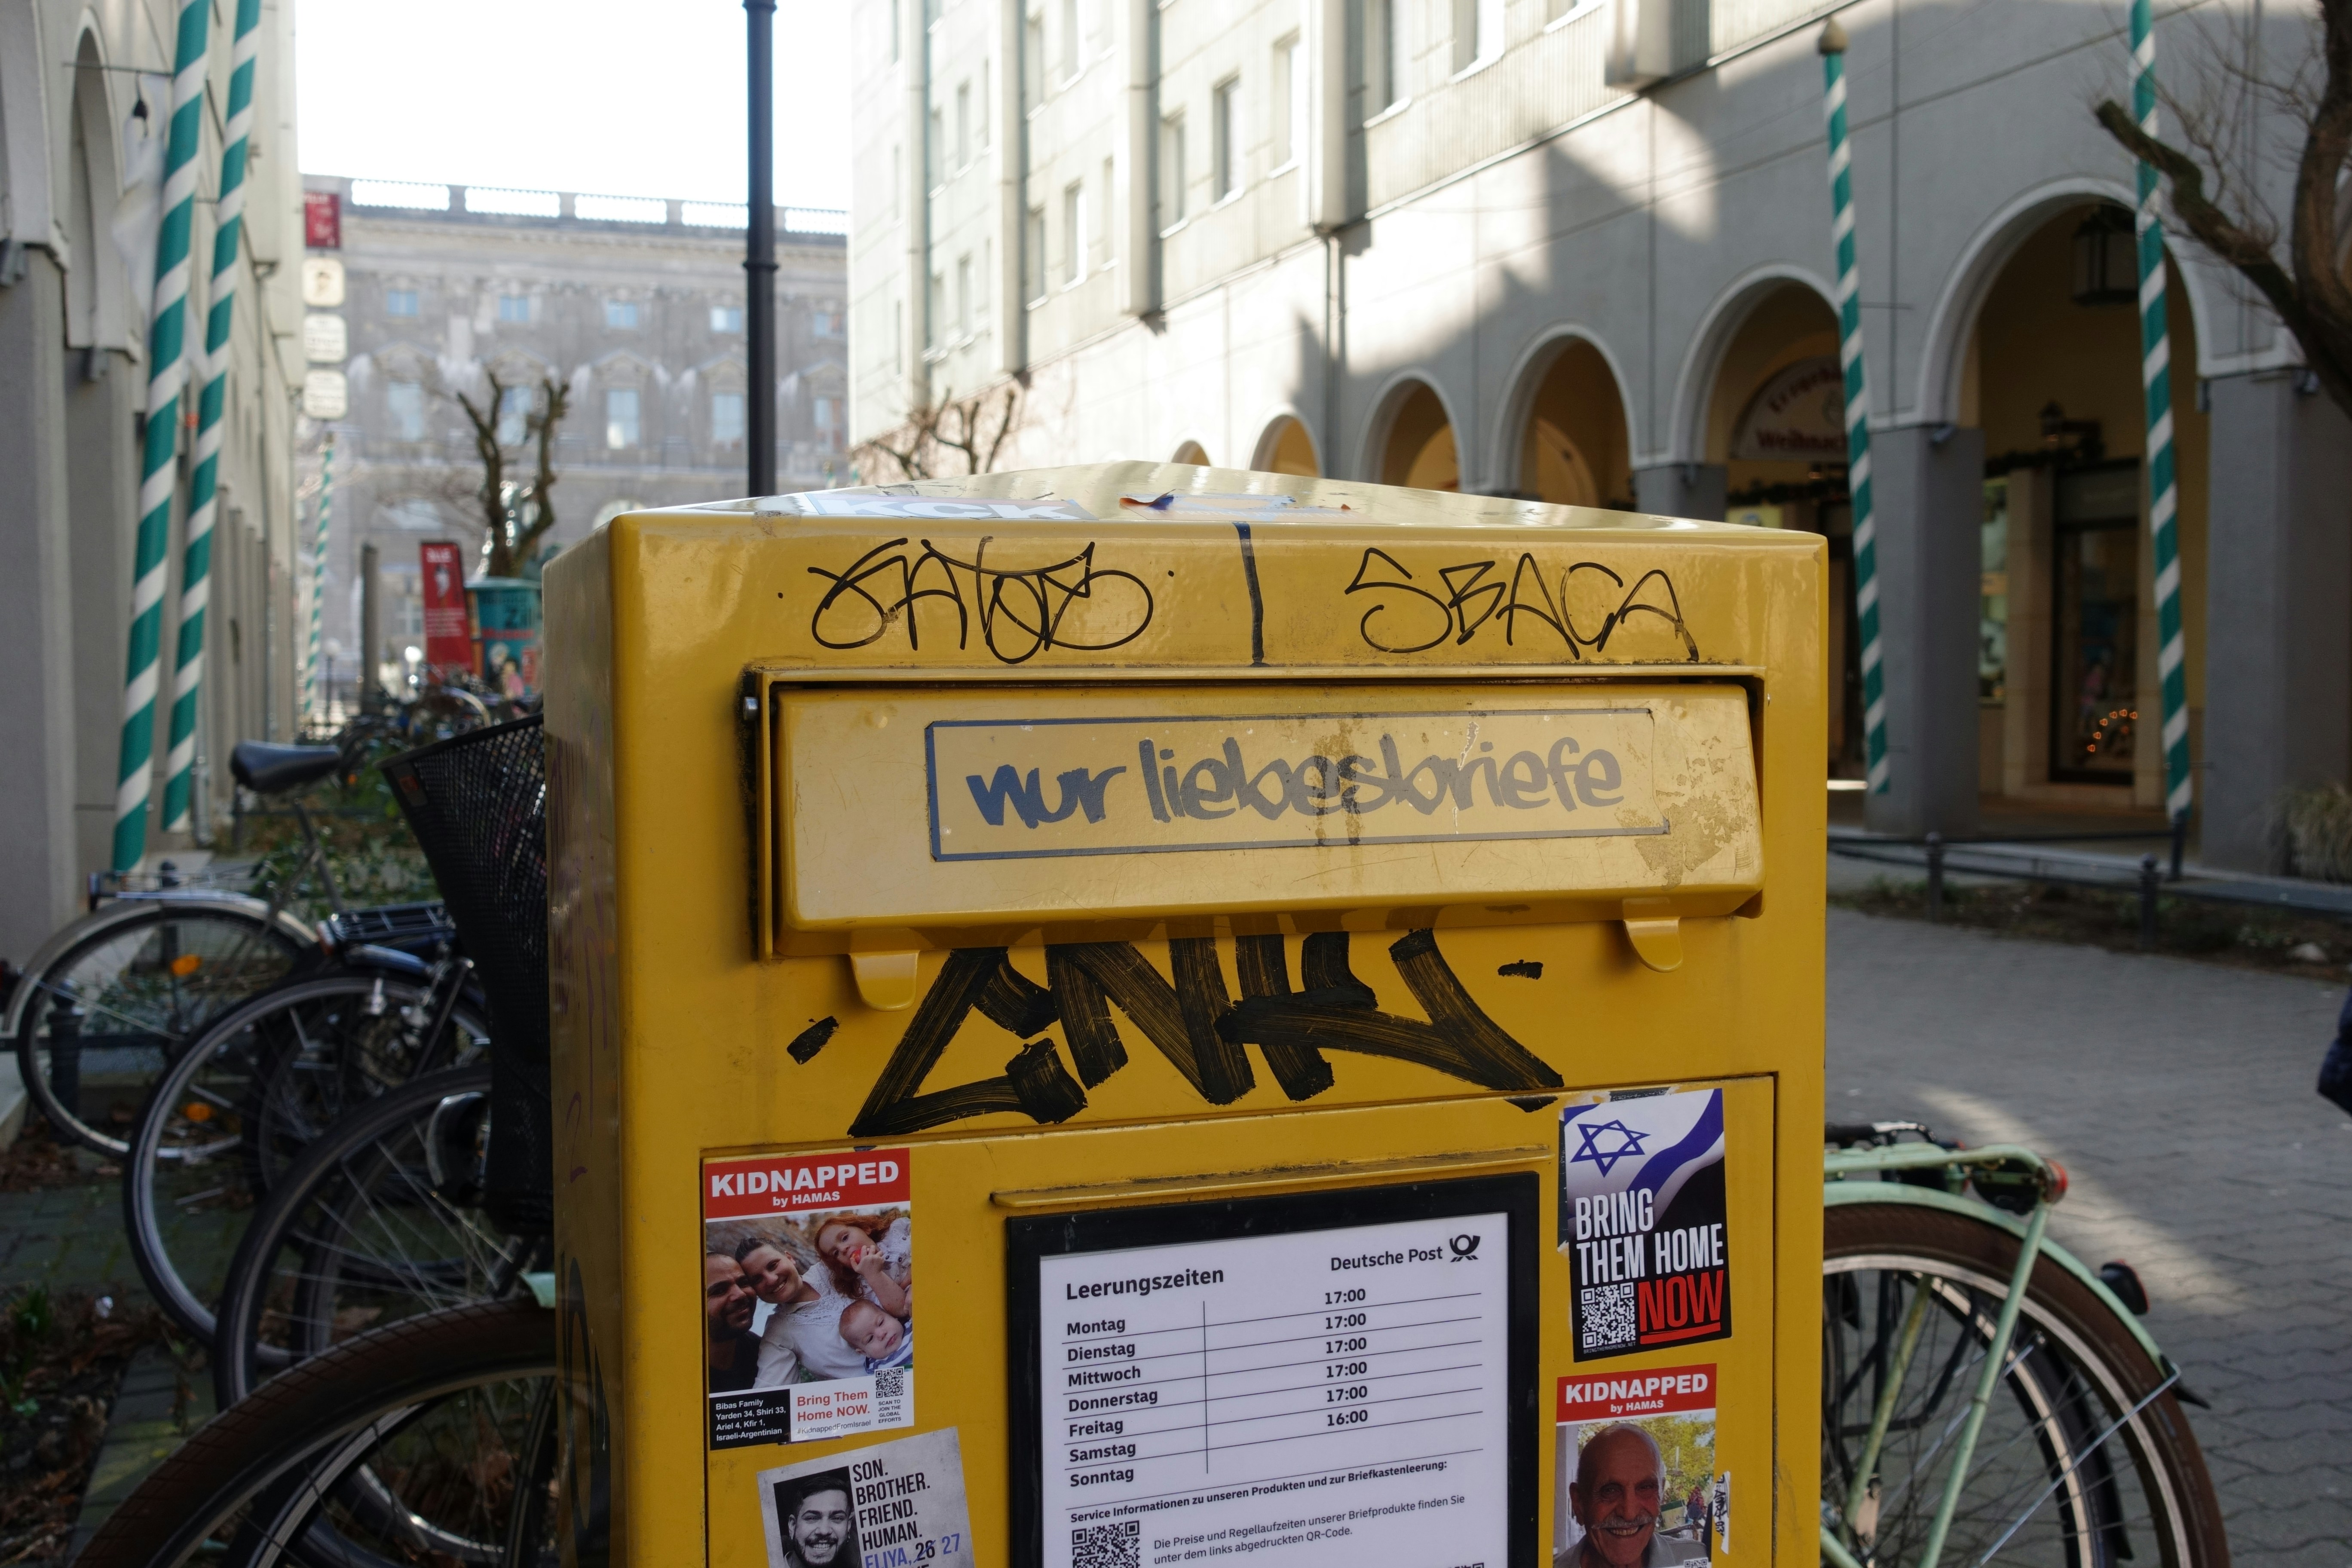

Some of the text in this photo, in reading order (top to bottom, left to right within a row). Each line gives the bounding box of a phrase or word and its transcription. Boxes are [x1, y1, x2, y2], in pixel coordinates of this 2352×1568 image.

[818, 499, 1082, 520] KCK
[966, 733, 1624, 830] nur liebesbriefe
[711, 1161, 899, 1197] KIDNAPPED
[773, 1191, 840, 1208] by HAMAS
[1575, 1188, 1654, 1240] BRING
[1331, 1246, 1443, 1271] Deutsche Post
[1576, 1223, 1724, 1286] THEM HOME
[1067, 1269, 1224, 1300] Leerungszeiten
[1067, 1288, 1366, 1335] Montag 17:00
[1638, 1270, 1724, 1332] NOW
[1068, 1313, 1366, 1361] Dienstag 17:00
[1583, 1341, 1636, 1354] BRINGTHEMHOMENOW.NET
[1069, 1337, 1367, 1387] Mittwoch 17:00
[797, 1390, 868, 1407] Bring Them
[1069, 1361, 1367, 1412] Donnerstag 17:00
[1566, 1373, 1708, 1403] KIDNAPPED
[716, 1399, 763, 1411] Bibas Family
[716, 1406, 786, 1421] Yarden 34, Shiri 33,
[797, 1404, 870, 1422] Home NOW.
[1069, 1385, 1368, 1437] Freitag 17:00
[1611, 1400, 1664, 1414] by HAMAS
[717, 1422, 734, 1431] Ariel
[744, 1419, 758, 1428] Kfir
[717, 1427, 782, 1441] Israeli-Argentinian
[797, 1420, 871, 1435] #KidnappedFromIsrael
[1069, 1409, 1368, 1462] Samstag 16:00
[853, 1458, 888, 1482] SON.
[1070, 1468, 1134, 1487] Sonntag
[856, 1472, 930, 1506] BROTHER.
[1071, 1461, 1447, 1523] Service Informationen zu unseren Produkten und zur Briefkastenleerung:
[859, 1499, 918, 1528] FRIEND.
[1154, 1494, 1465, 1549] Die Preise und Regellaufzeiten unserer Briefprodukte finden Sie
[862, 1521, 922, 1551] HUMAN.
[942, 1533, 960, 1555] 27
[1154, 1526, 1353, 1564] unter dem links abgedruckten QR-Code.
